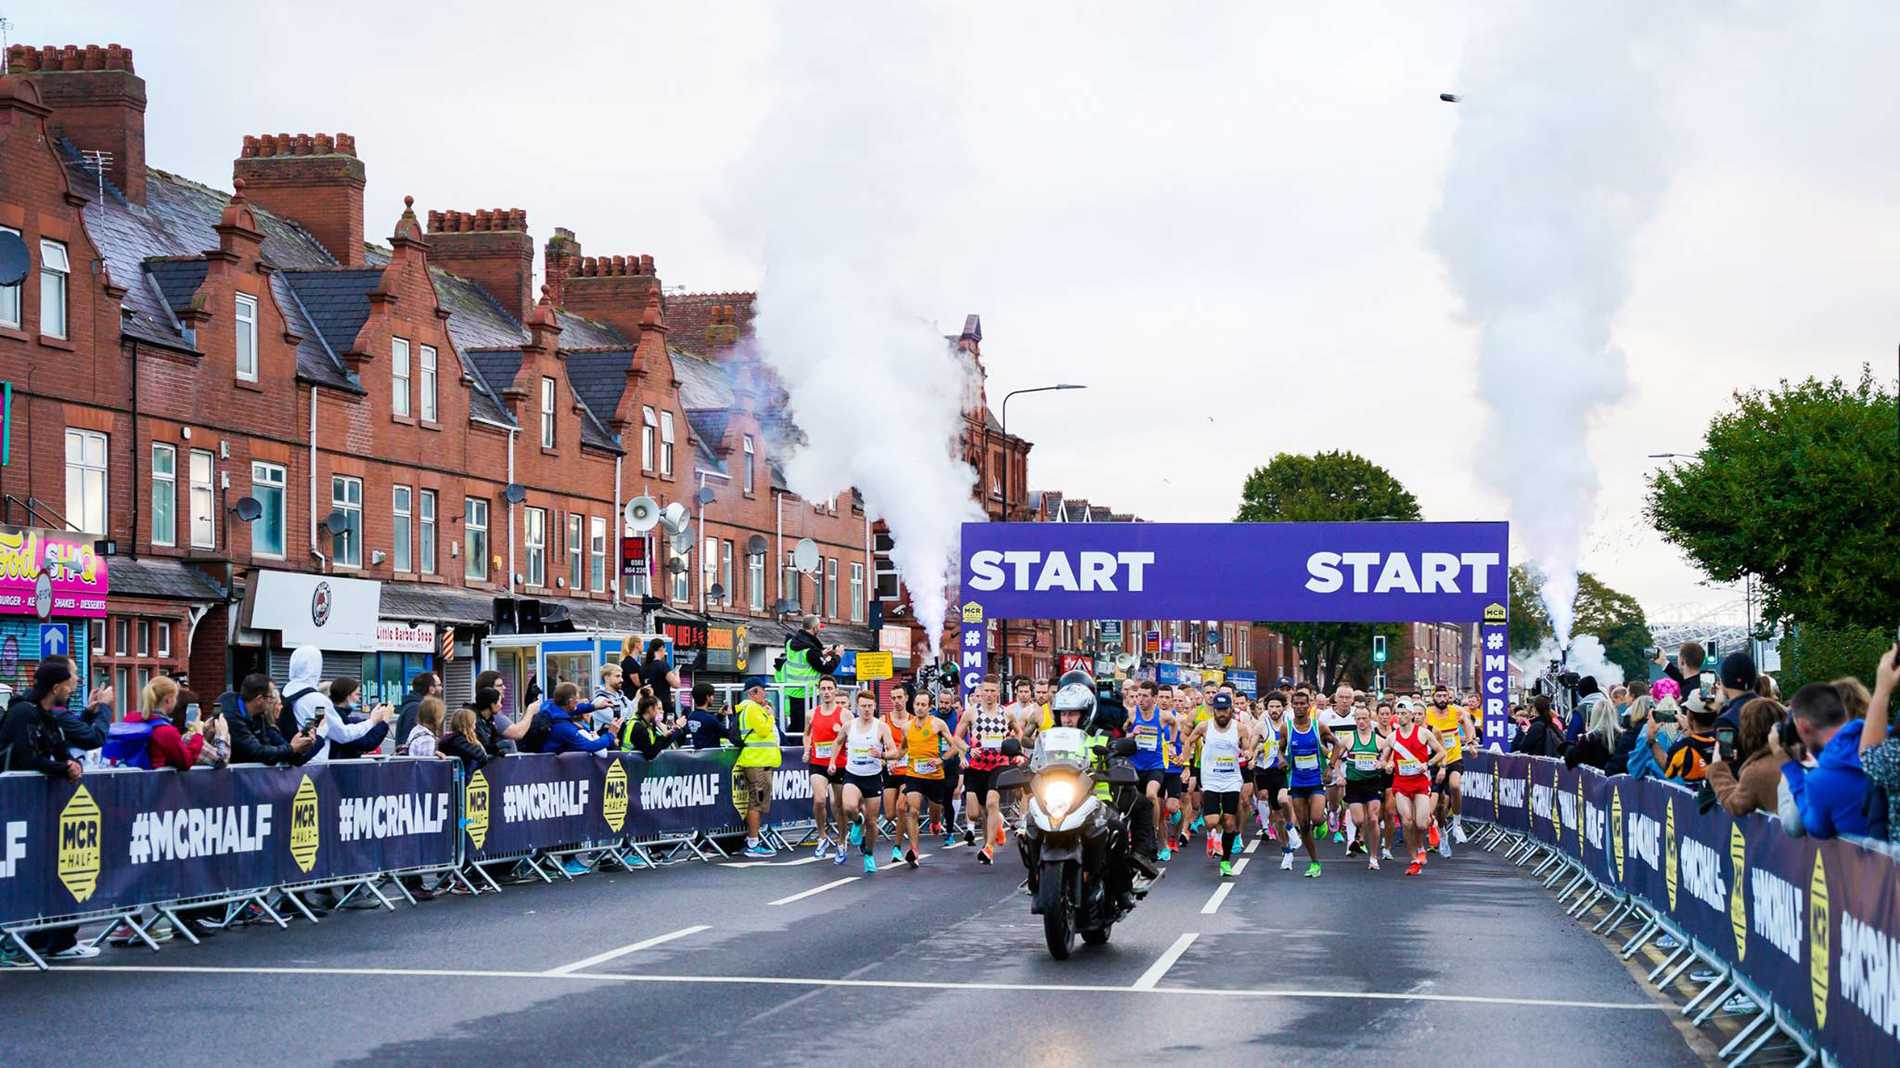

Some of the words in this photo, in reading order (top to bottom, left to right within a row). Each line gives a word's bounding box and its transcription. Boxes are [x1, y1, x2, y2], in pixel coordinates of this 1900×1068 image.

[968, 550, 1155, 591] START
[1305, 552, 1500, 594] START
[964, 607, 982, 615] MCR
[1486, 609, 1505, 617] MCR
[376, 626, 393, 640] Little
[395, 627, 416, 641] Barber
[418, 628, 433, 645] Shop
[963, 630, 982, 710] #MC
[469, 791, 487, 812] MCR
[503, 780, 589, 823] #MCRHALF
[607, 781, 626, 800] MCR
[641, 773, 720, 810] #MCRHALF
[294, 803, 315, 829] MCR
[339, 793, 448, 841] #MCRHALF
[62, 820, 98, 850] MCR
[129, 804, 272, 864] #MCRHALF
[66, 852, 92, 867] HALF
